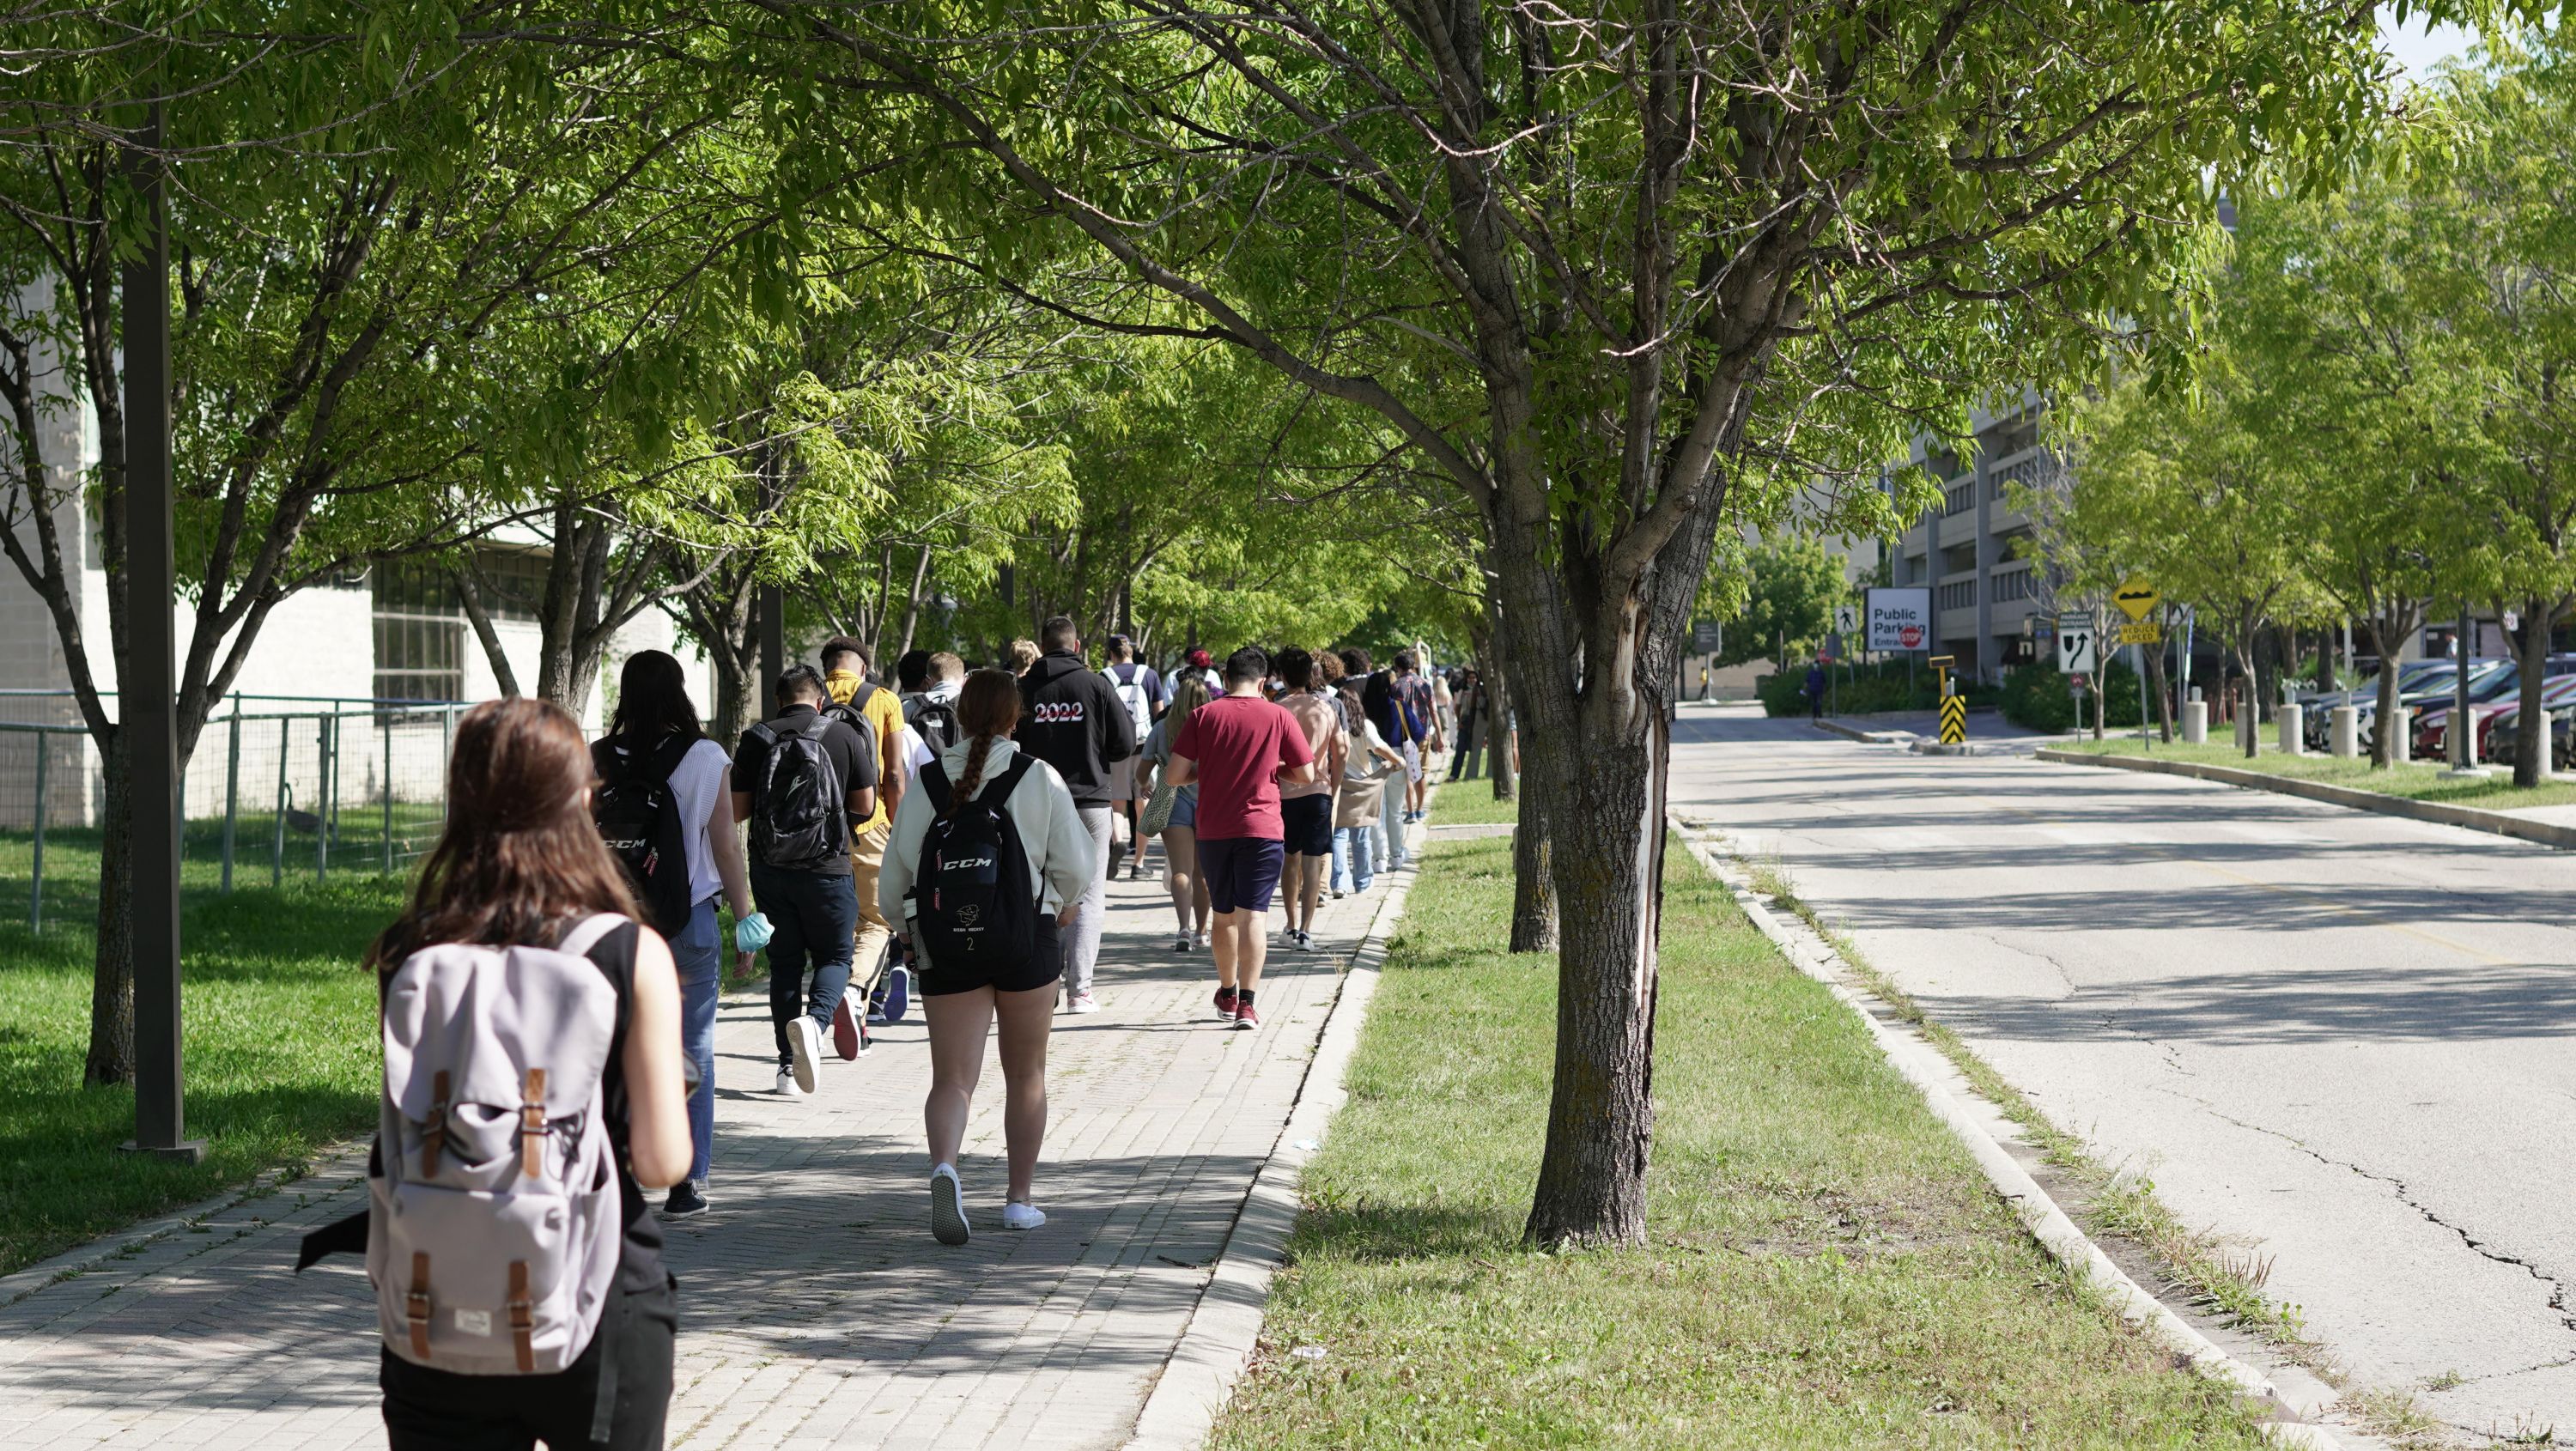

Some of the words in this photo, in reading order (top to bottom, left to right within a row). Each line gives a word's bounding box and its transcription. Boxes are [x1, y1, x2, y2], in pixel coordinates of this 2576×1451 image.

[1874, 608, 1917, 620] Public
[1874, 622, 1926, 636] Parkg
[2123, 626, 2155, 634] REDUCE
[1901, 632, 1920, 642] STOP
[1034, 701, 1084, 723] 2022
[603, 839, 646, 849] CCM
[944, 858, 992, 871] CCM
[967, 937, 975, 950] 2
